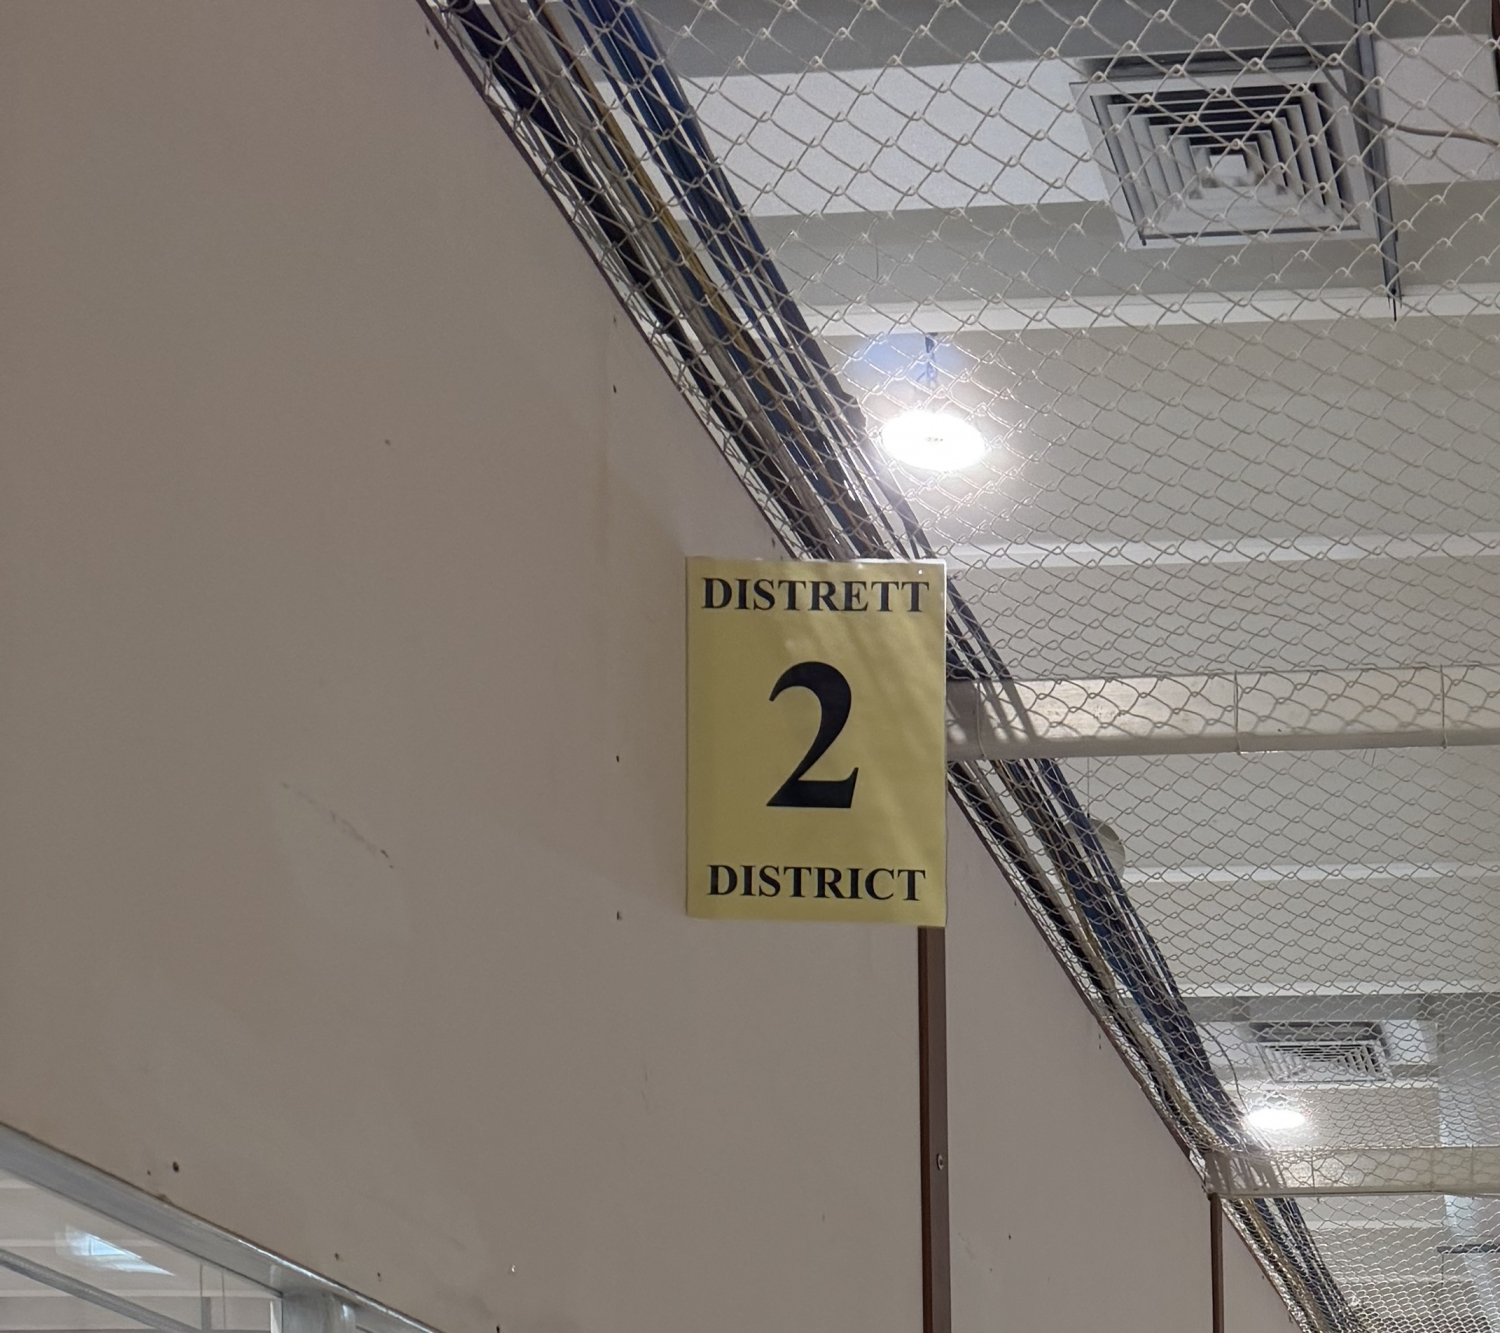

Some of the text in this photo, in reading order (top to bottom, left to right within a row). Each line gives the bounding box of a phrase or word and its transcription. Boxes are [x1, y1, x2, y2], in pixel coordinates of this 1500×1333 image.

[701, 577, 930, 614] DISTRETT
[765, 660, 860, 809] 2
[706, 864, 926, 902] DISTRICT
